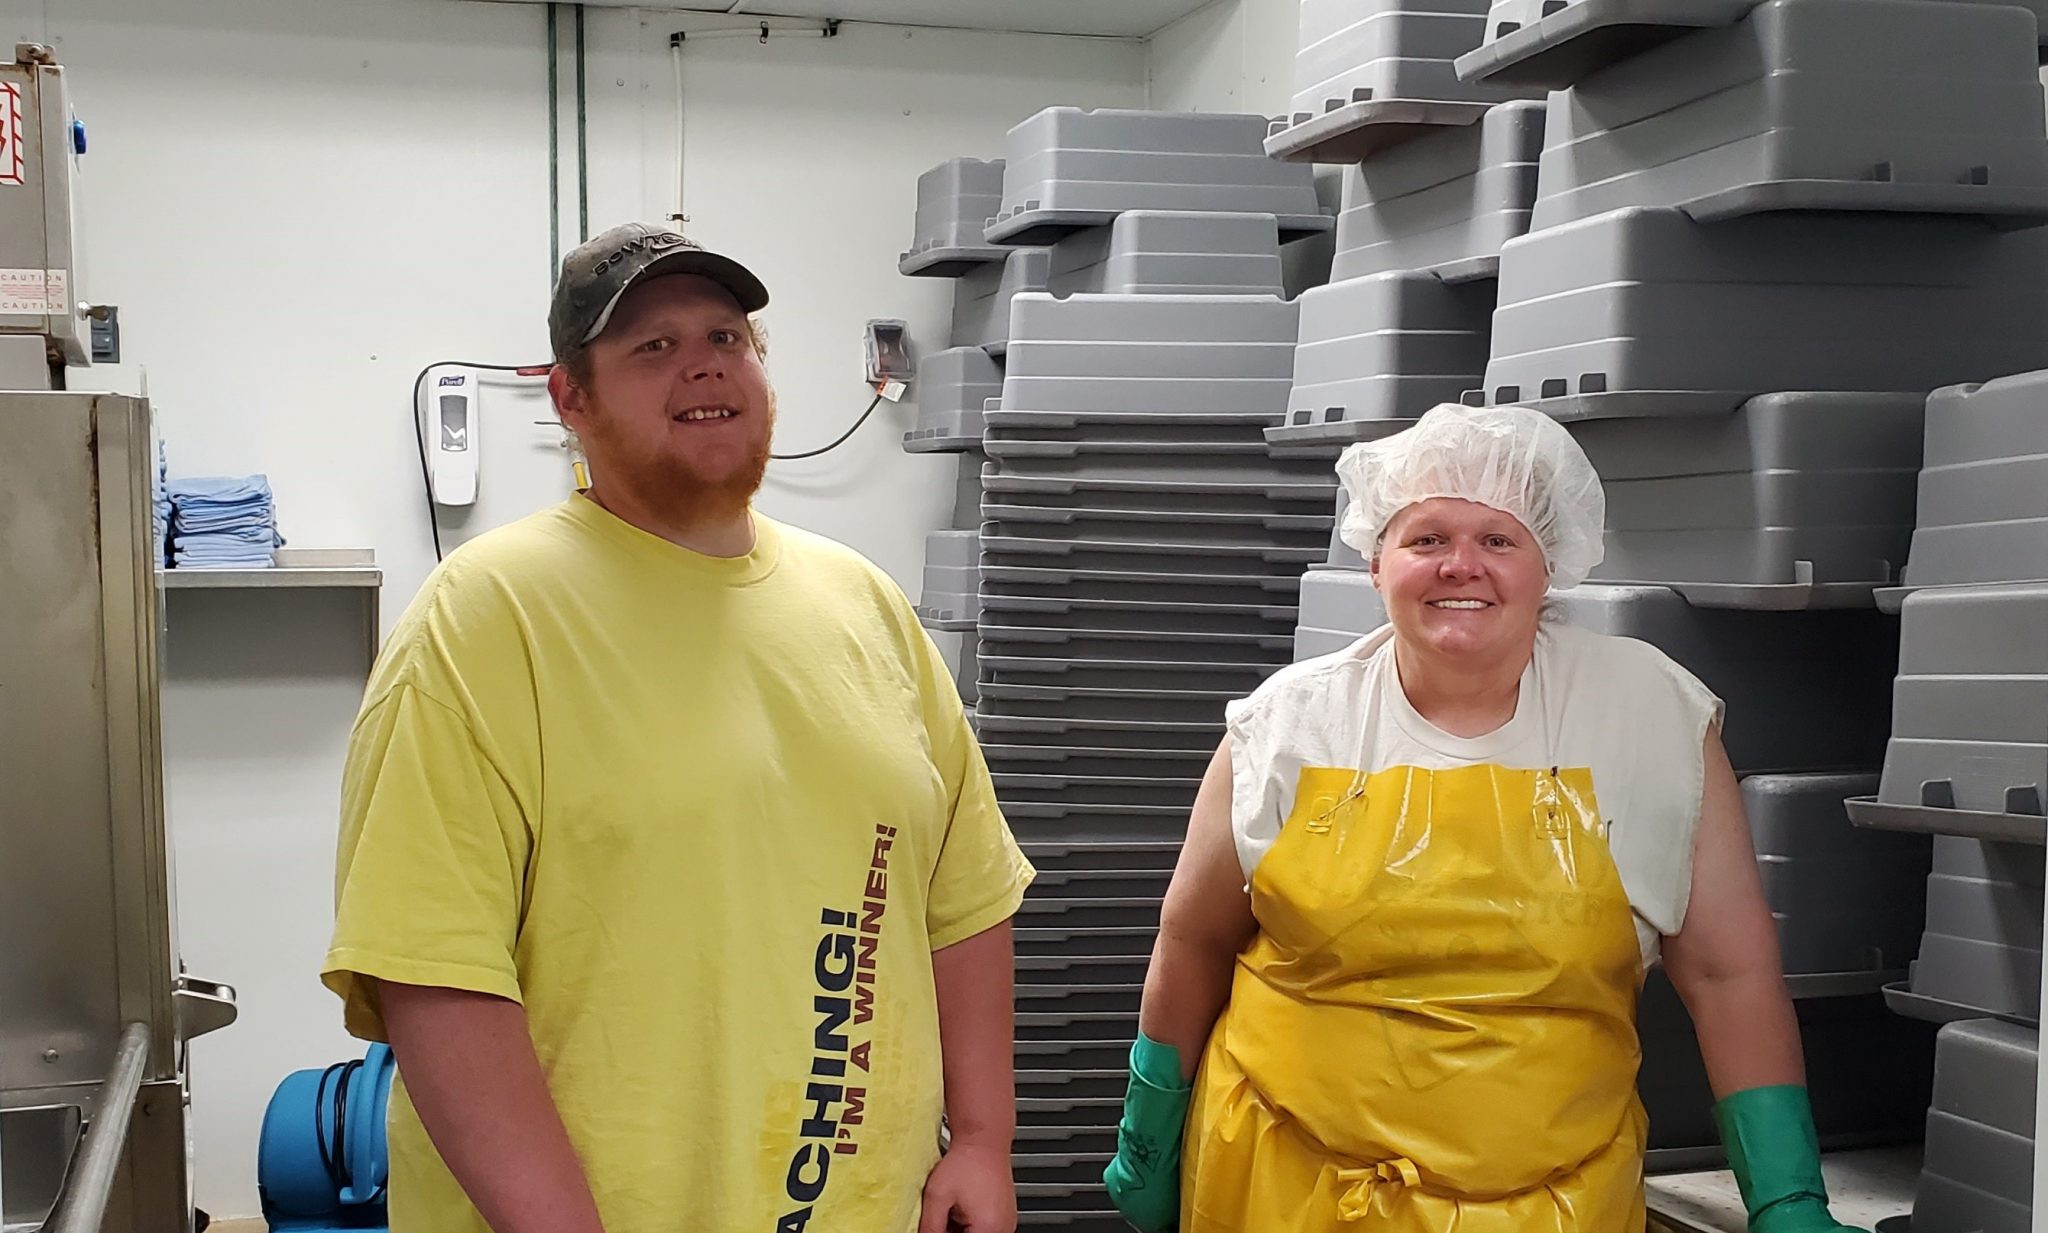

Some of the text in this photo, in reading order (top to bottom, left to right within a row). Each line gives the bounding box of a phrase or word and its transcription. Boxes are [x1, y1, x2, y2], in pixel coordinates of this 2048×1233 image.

[833, 822, 897, 1155] I'M A WINNER!
